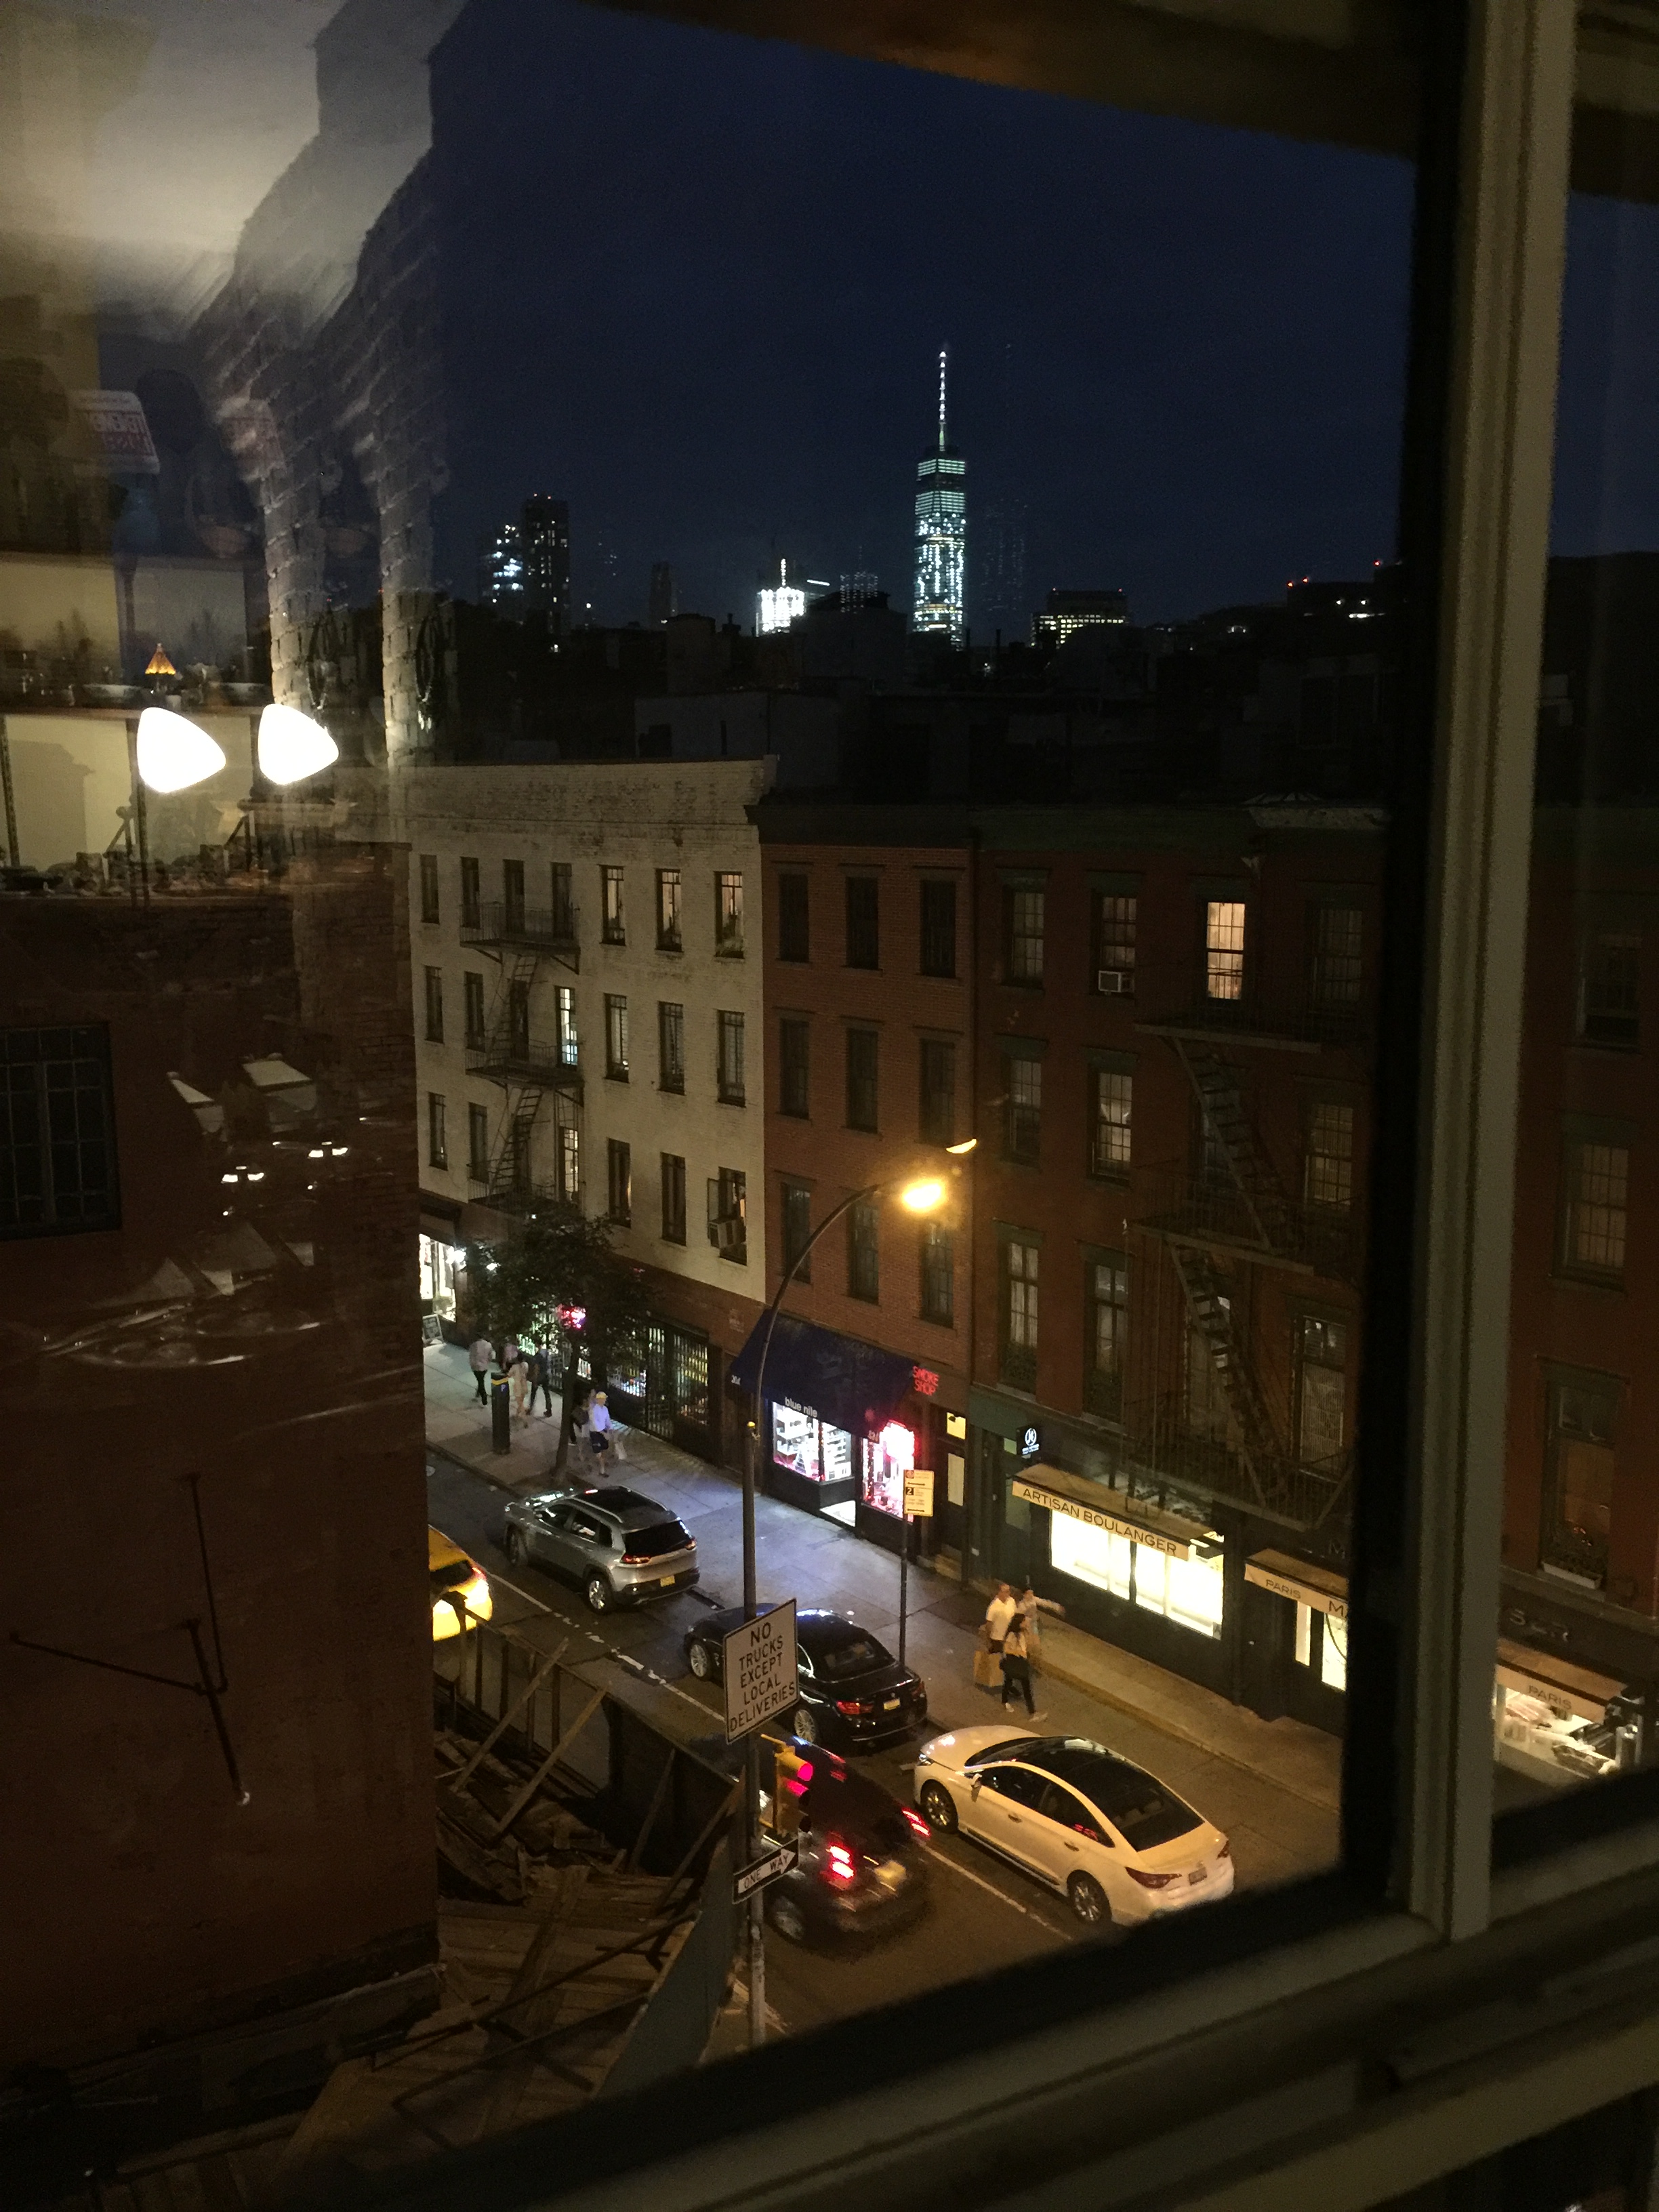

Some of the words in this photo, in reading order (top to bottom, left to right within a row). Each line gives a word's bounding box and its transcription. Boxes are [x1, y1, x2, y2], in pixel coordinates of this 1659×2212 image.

[912, 1366, 939, 1387] SMOKE
[914, 1378, 937, 1396] SHOP
[785, 1397, 802, 1412] blue
[803, 1406, 817, 1418] nile
[1023, 1488, 1080, 1519] ARTISAN
[1084, 1510, 1176, 1556] BOULANGER
[1265, 1579, 1301, 1599] PARIS
[750, 1622, 771, 1647] NO
[739, 1635, 783, 1671] TRUCKS
[741, 1652, 783, 1688] EXCEPT
[744, 1673, 781, 1706] LOCAL
[1528, 1685, 1572, 1711] PARIS
[729, 1681, 795, 1732] DELIVERIES
[743, 1867, 761, 1889] ONE
[770, 1852, 790, 1872] WAY
